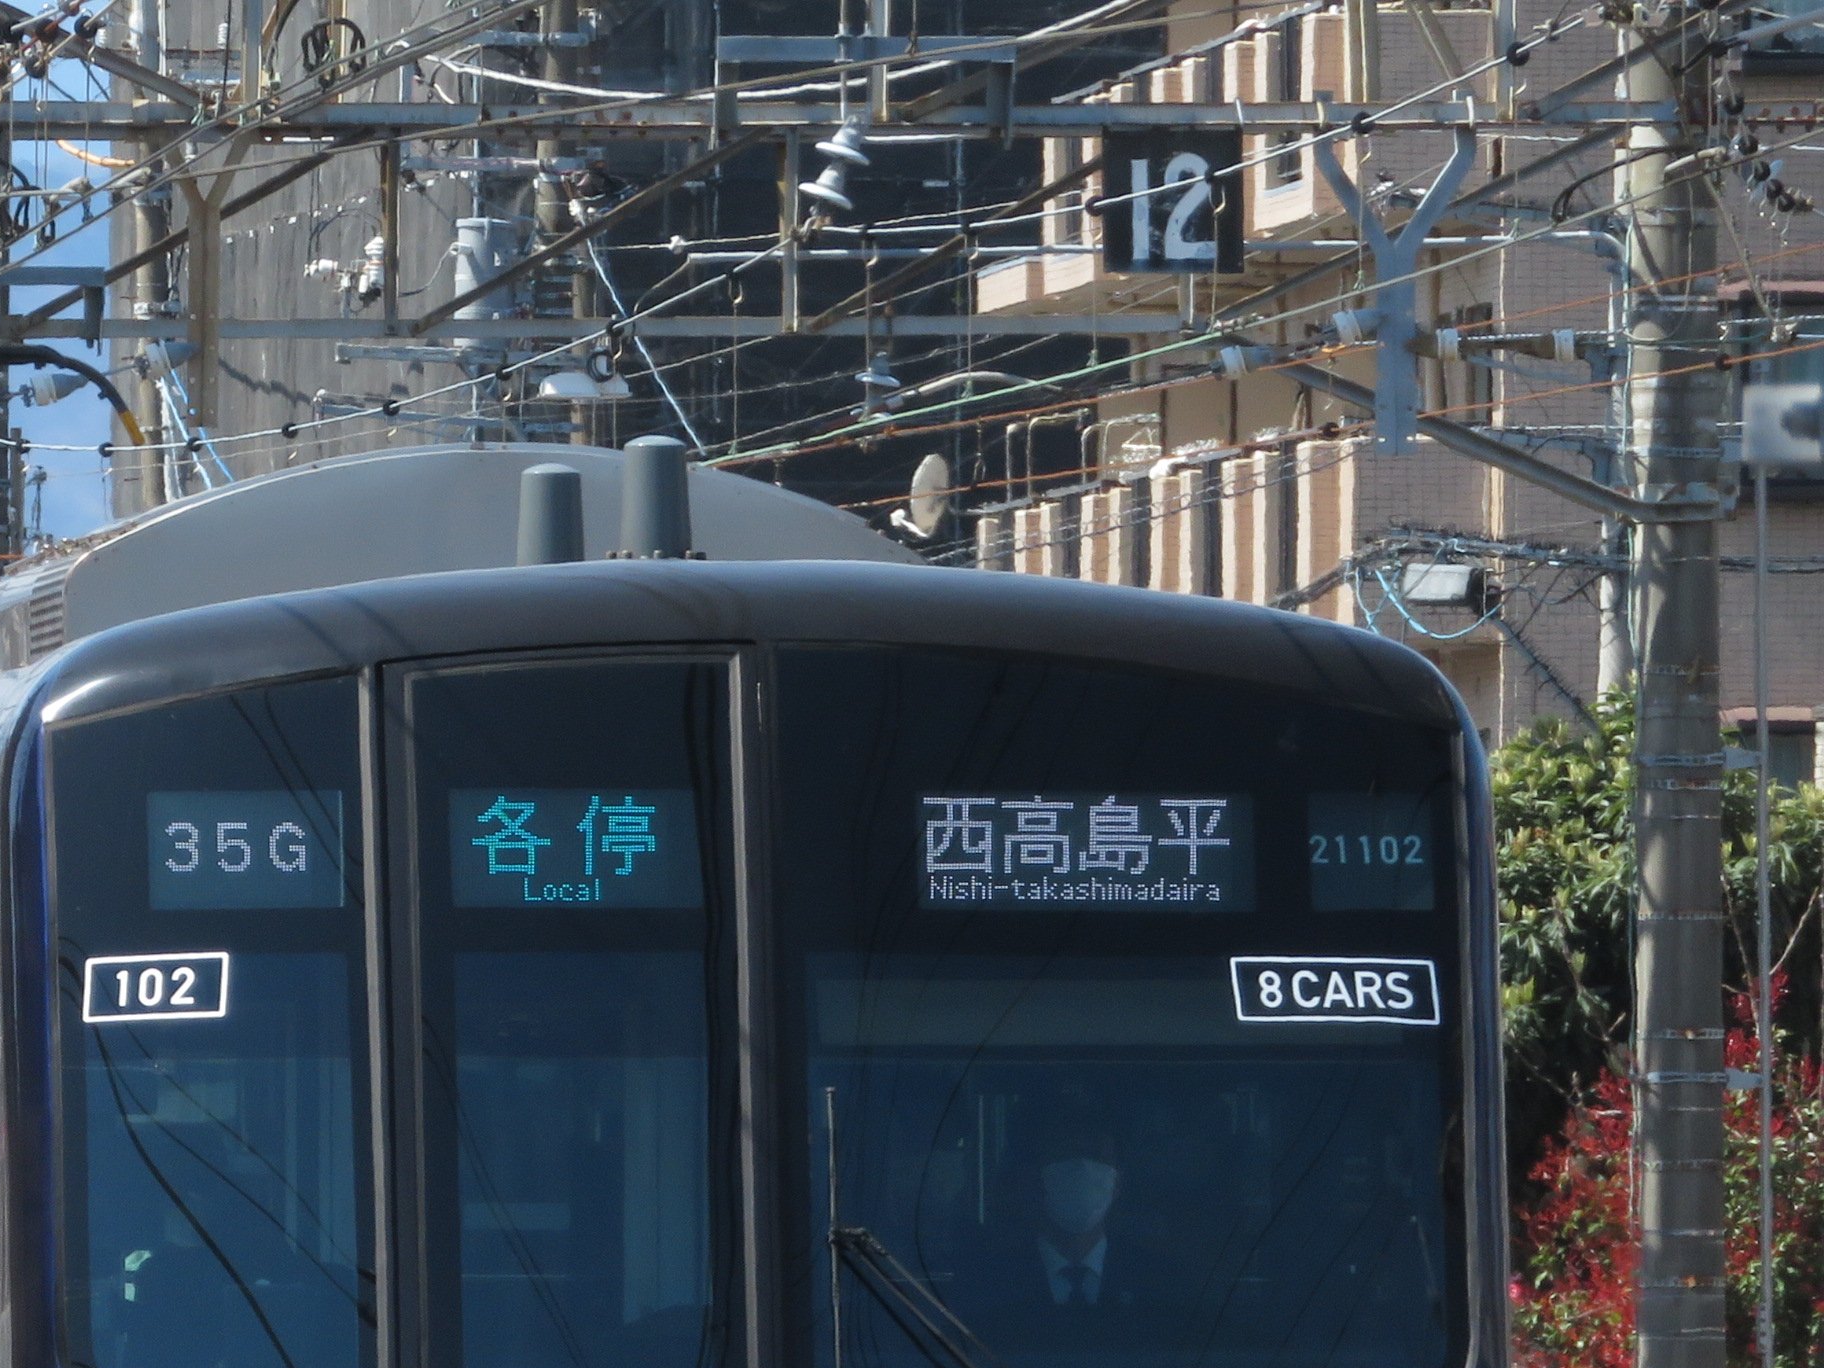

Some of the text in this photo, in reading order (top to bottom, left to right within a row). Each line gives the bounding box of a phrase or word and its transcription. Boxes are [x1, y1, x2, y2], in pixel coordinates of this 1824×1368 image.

[1130, 151, 1218, 261] 12
[163, 821, 308, 873] 35G
[471, 795, 657, 876] 各停
[922, 795, 1231, 875] 西高島平
[1308, 834, 1425, 866] 21102
[523, 878, 601, 901] Local
[928, 875, 1221, 901] Nishi-takashimadaira
[114, 966, 197, 1008] 102
